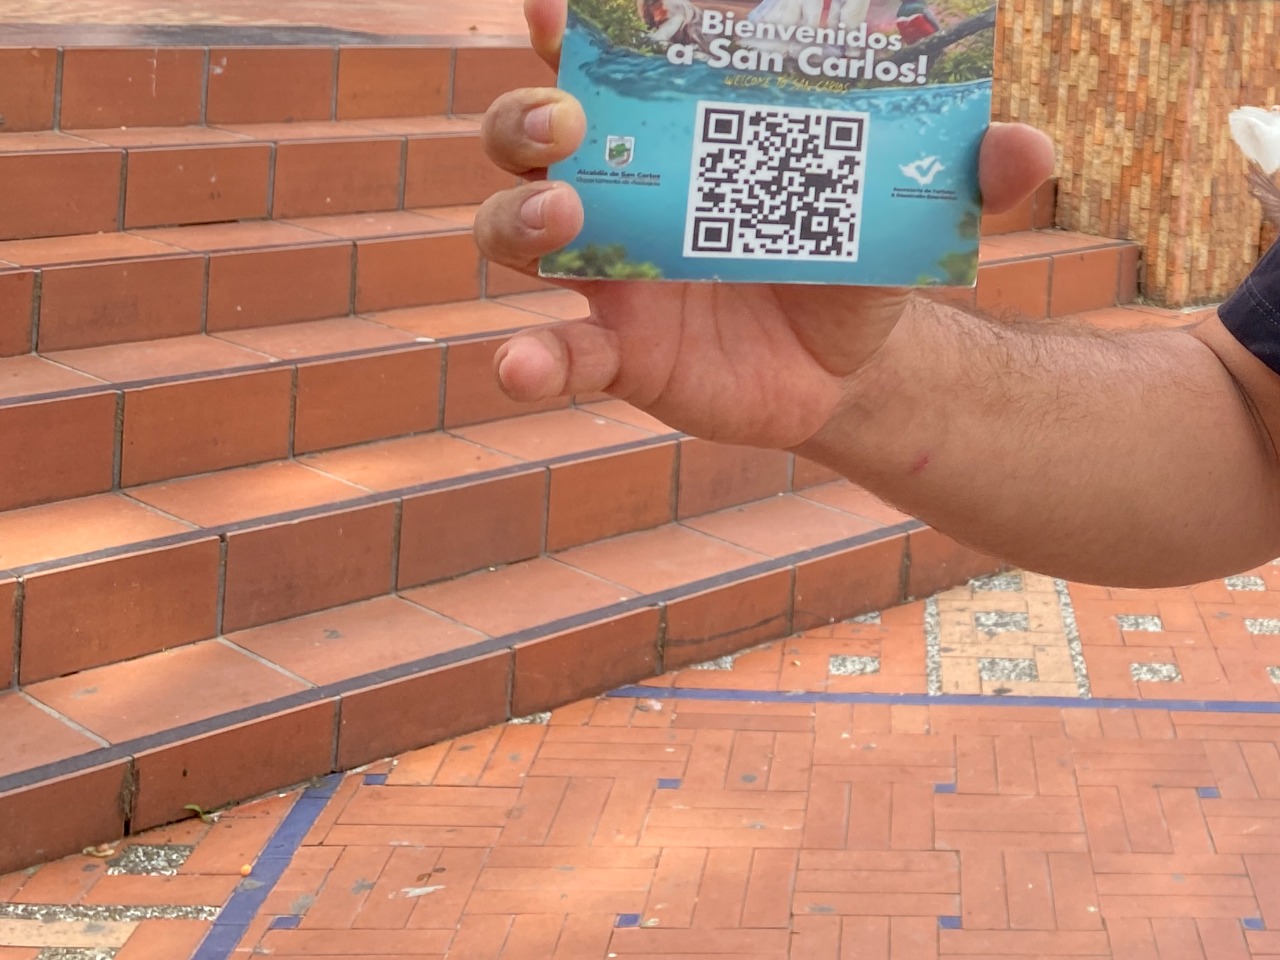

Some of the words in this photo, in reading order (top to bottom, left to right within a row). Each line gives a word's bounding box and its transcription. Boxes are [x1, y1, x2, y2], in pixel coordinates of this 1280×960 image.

[701, 9, 902, 51] Bienvenidos
[666, 42, 694, 66] a
[707, 38, 784, 73] San
[798, 46, 929, 85] Carlos!
[724, 73, 773, 88] WELCOME
